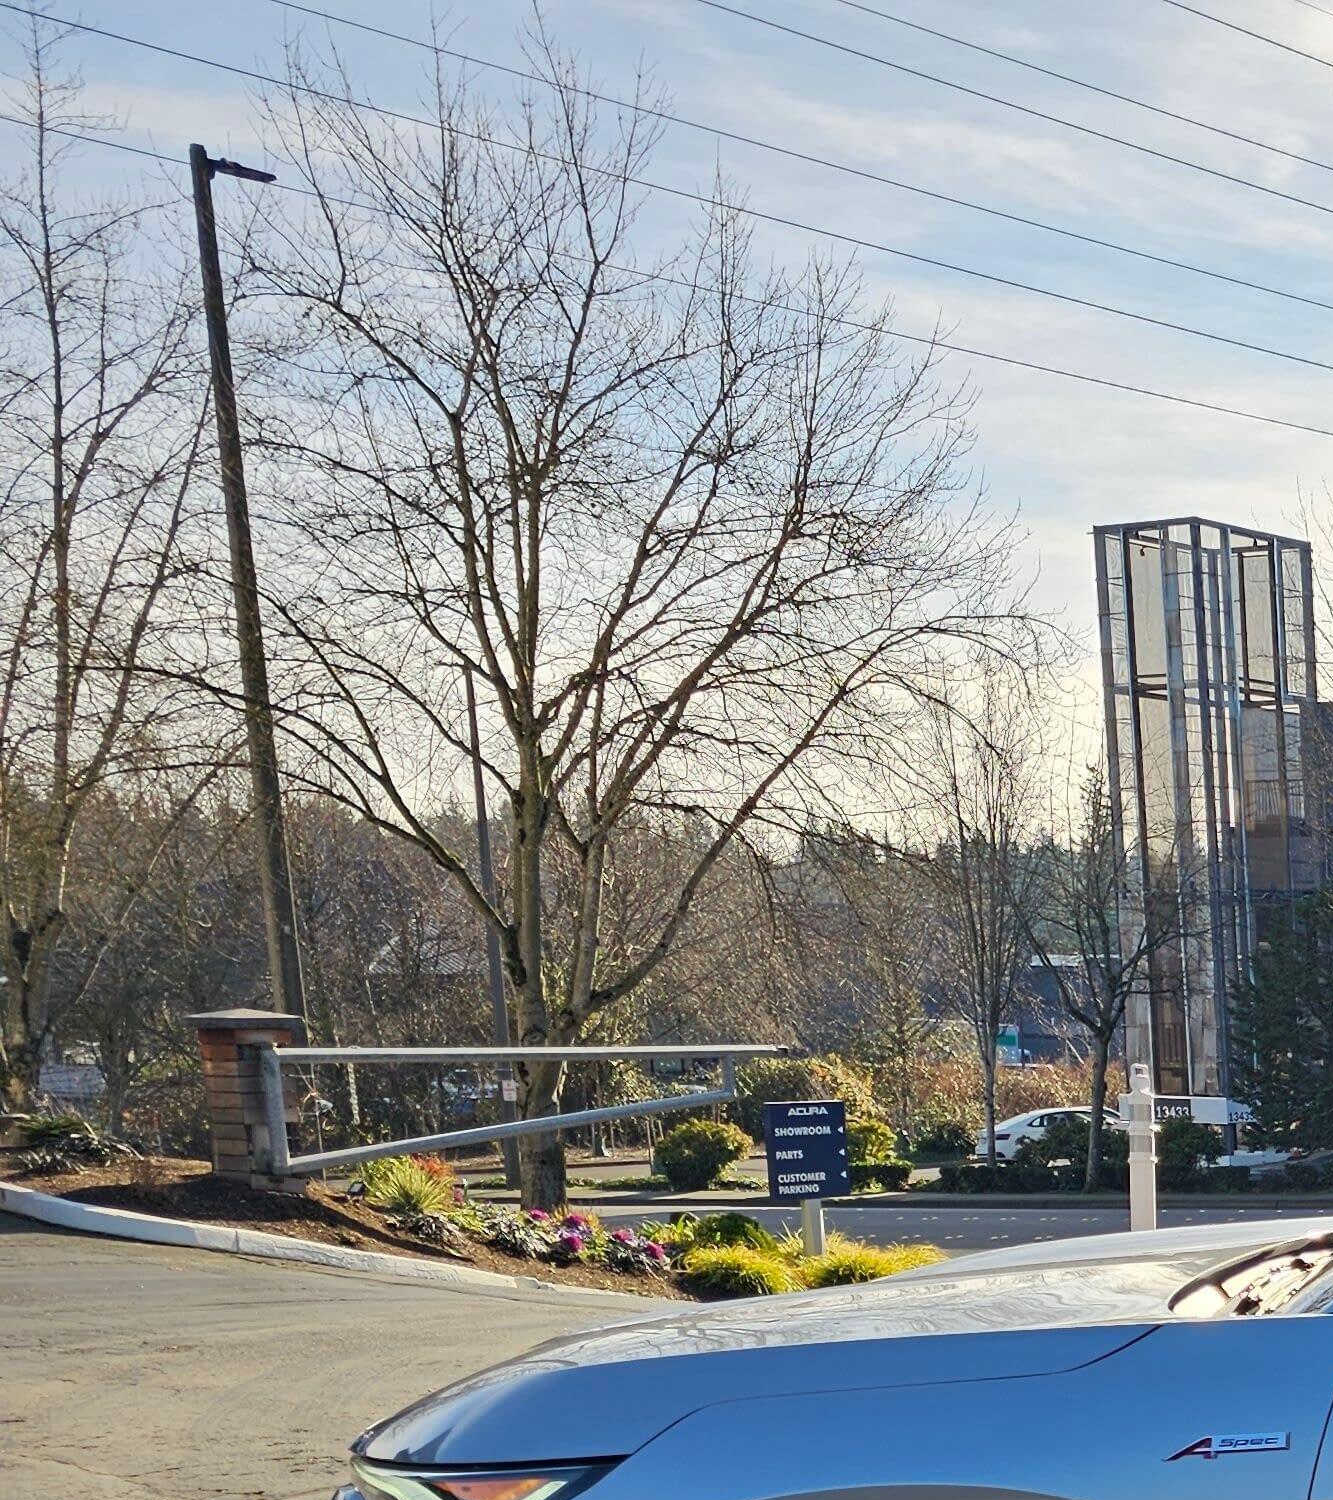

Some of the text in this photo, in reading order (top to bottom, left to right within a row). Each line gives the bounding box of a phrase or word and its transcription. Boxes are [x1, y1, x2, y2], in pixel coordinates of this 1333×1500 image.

[787, 1106, 829, 1117] ACURA
[1155, 1105, 1190, 1119] 13433
[774, 1125, 832, 1137] SHOWROOM
[775, 1149, 804, 1161] PARTS
[777, 1171, 827, 1184] CUSTOMER
[778, 1183, 820, 1195] PARKING
